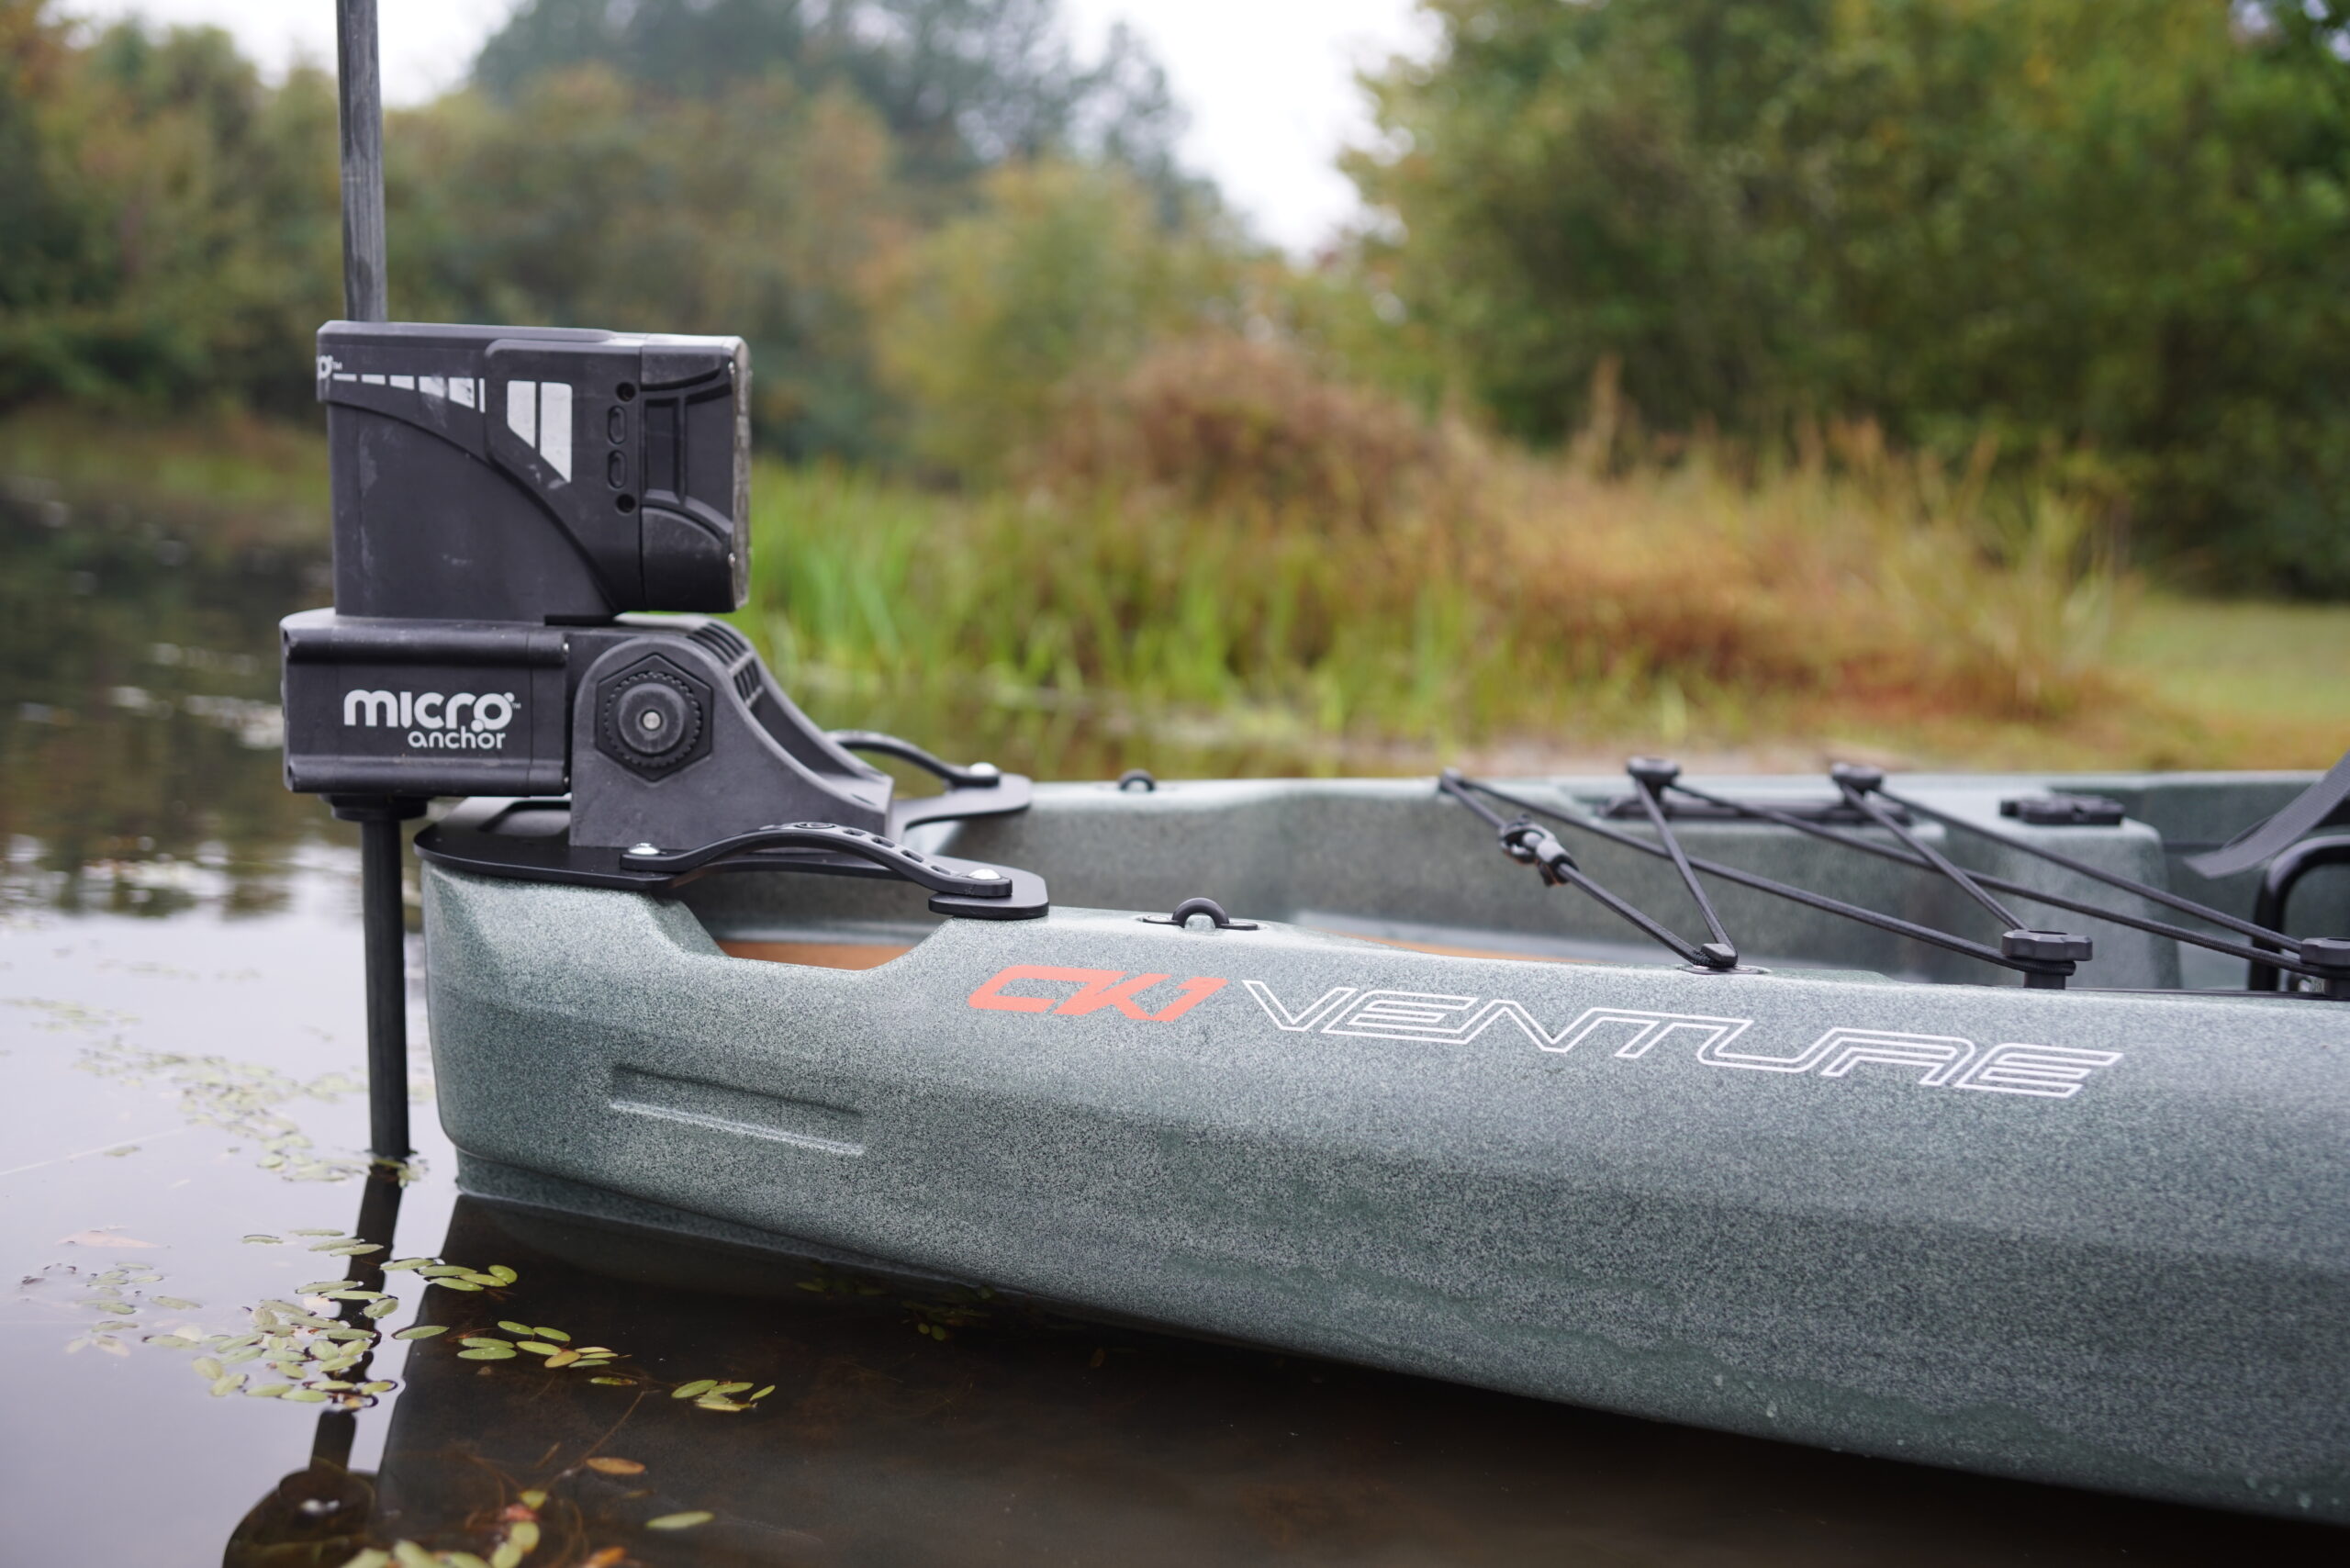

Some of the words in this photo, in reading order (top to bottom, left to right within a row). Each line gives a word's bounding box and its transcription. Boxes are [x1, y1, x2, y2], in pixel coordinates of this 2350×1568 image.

[407, 725, 507, 749] anchor
[968, 965, 1229, 1022] CK1
[1241, 979, 2125, 1098] VENTURE
